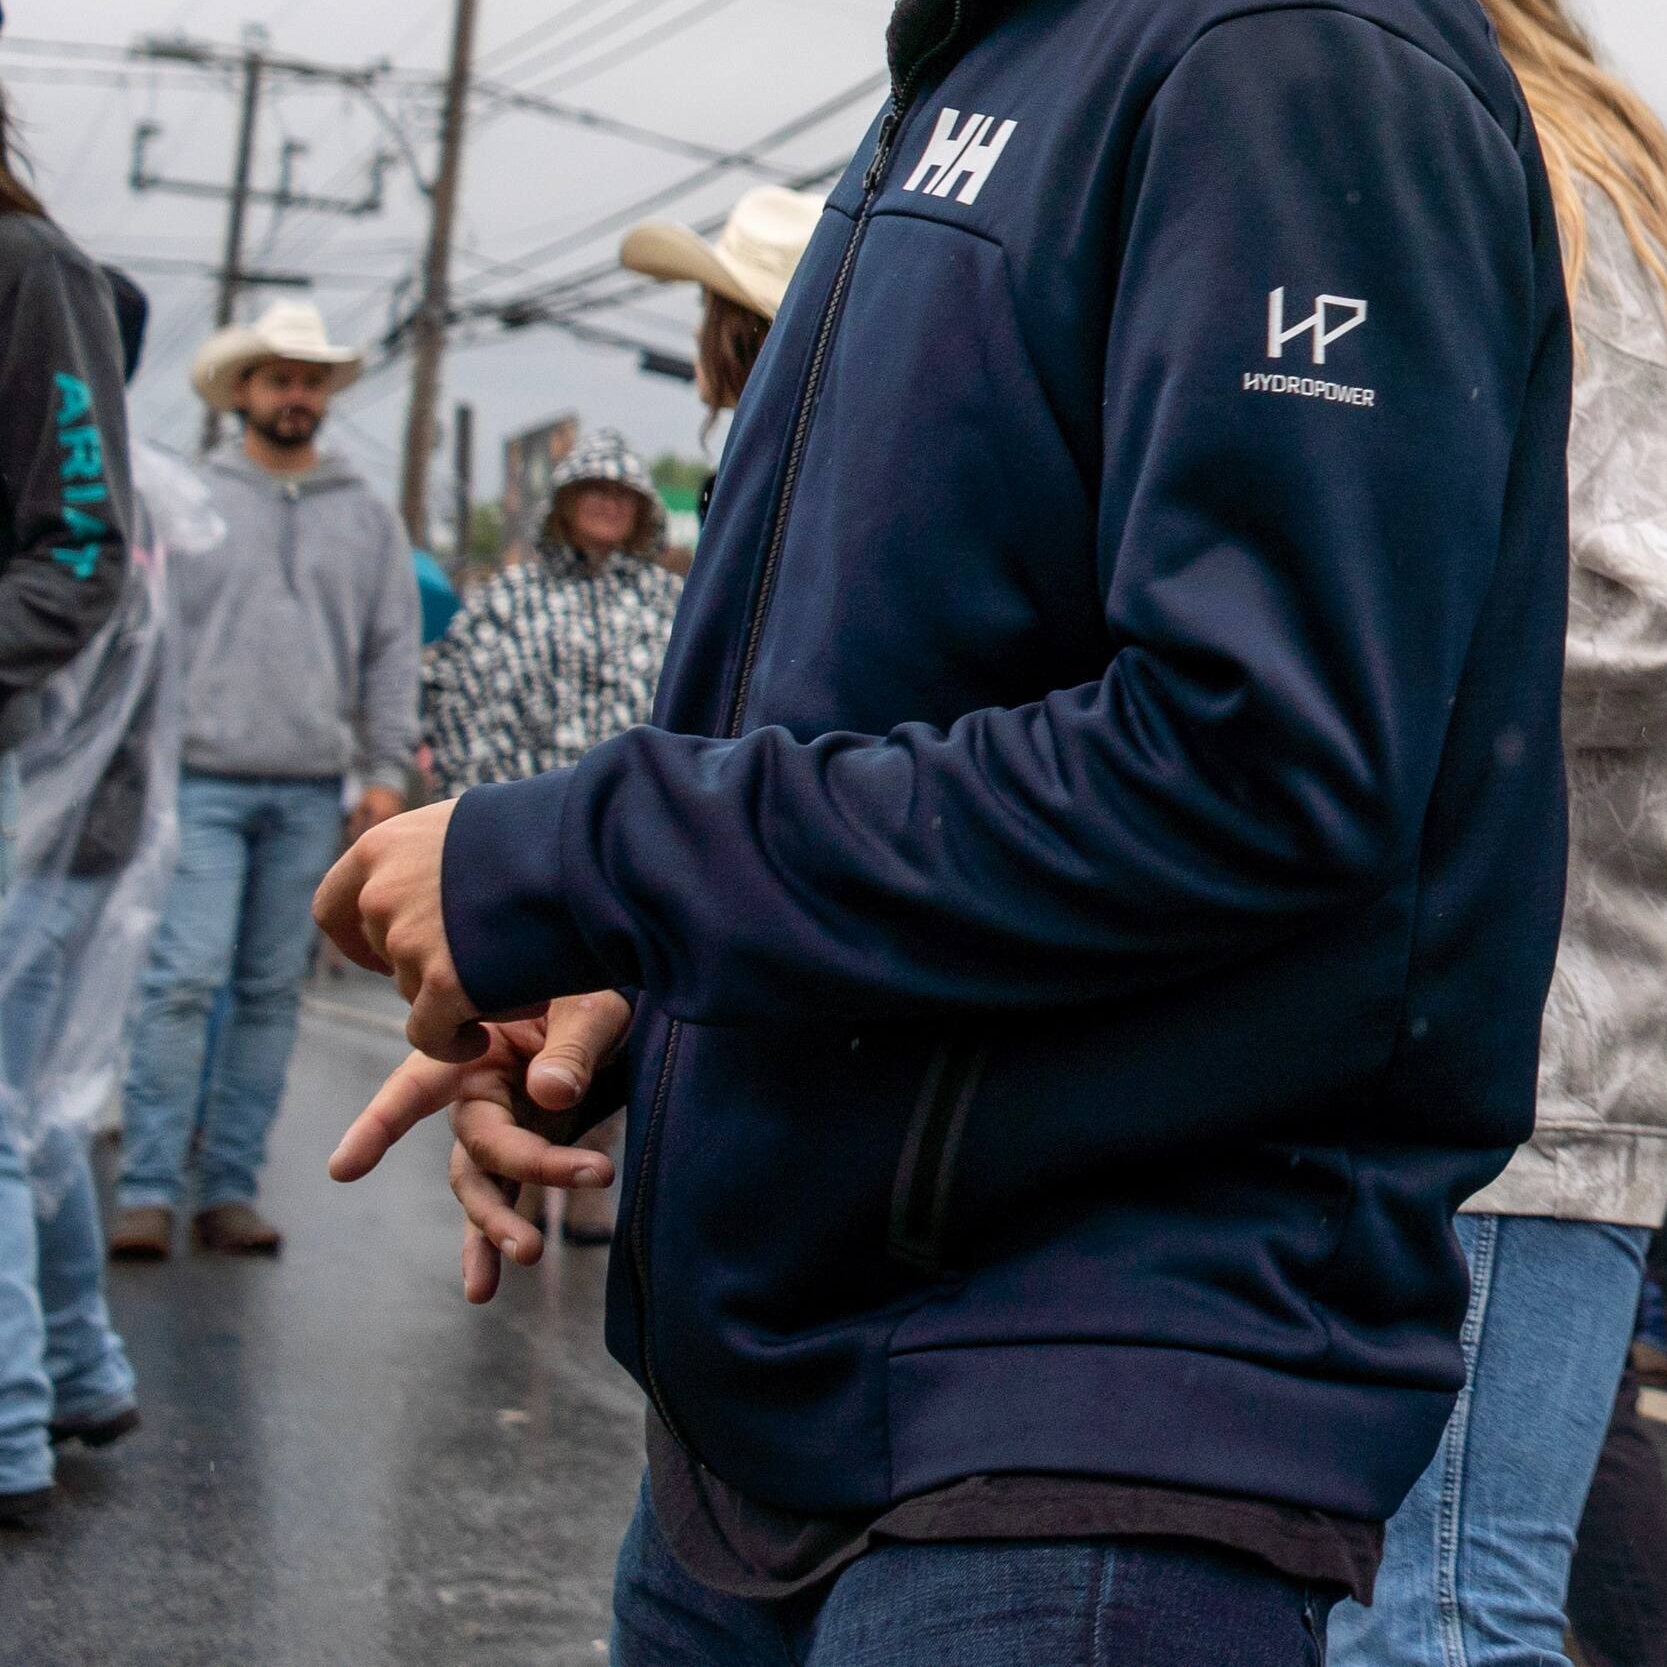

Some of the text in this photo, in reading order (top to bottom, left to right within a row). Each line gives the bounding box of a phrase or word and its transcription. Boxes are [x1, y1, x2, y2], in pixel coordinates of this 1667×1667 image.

[903, 107, 1018, 205] HH
[1242, 371, 1376, 408] HYDROPOWER
[52, 371, 108, 580] ARIAT
